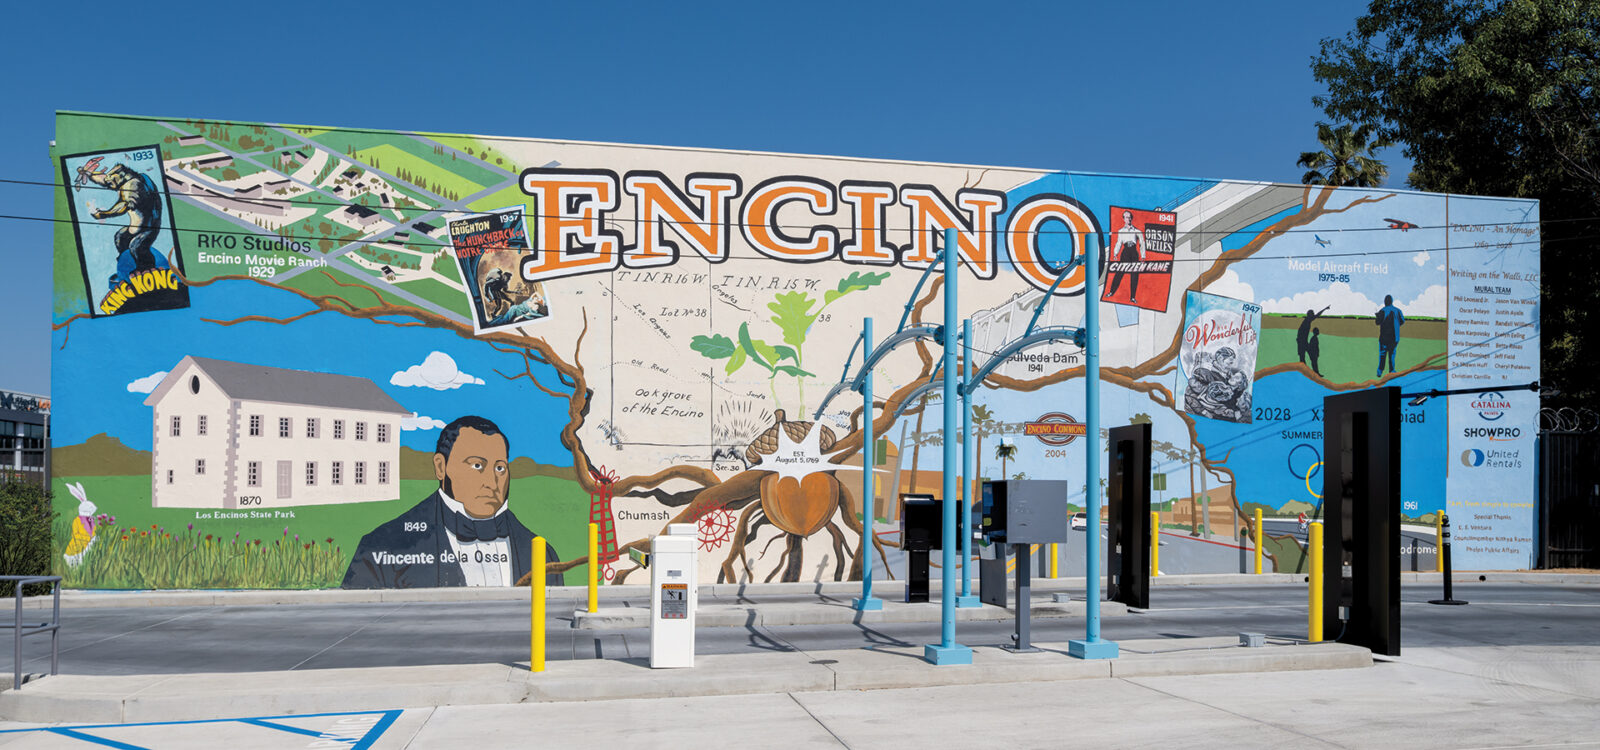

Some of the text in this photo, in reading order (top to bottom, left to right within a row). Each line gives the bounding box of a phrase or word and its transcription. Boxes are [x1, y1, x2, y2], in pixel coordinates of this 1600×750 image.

[133, 150, 154, 161] 1933
[500, 212, 519, 223] 1937
[1159, 214, 1174, 222] 1941
[451, 221, 490, 236] LAUGHTON
[519, 168, 1104, 296] ENCINO
[466, 228, 515, 247] HUNCHBACK
[1145, 228, 1174, 242] ORSON
[197, 234, 311, 253] RKO Studios
[1145, 239, 1173, 253] WELLES
[198, 252, 328, 267] Encino Movie Ranch
[248, 266, 275, 278] 1929
[1109, 262, 1170, 273] CITIZEN KANE
[1288, 260, 1388, 274] Model Aircraft Field
[1318, 273, 1350, 283] 1975-85
[1450, 268, 1477, 280] Writing
[1489, 271, 1500, 279] the
[100, 269, 178, 315] KING KONG
[1474, 286, 1511, 295] MURAL TEAM
[695, 308, 707, 317] 38
[1242, 304, 1260, 313] 1947
[818, 314, 832, 323] 38
[1007, 352, 1078, 364] pulveda Dam
[1028, 364, 1043, 372] 1941
[656, 390, 692, 405] grove
[622, 402, 639, 413] of
[640, 402, 657, 415] the
[1471, 401, 1511, 409] CATALINA
[1255, 408, 1291, 421] 2028
[1281, 430, 1323, 440] SUMMER
[1464, 428, 1520, 437] SHOWPRO
[1045, 449, 1066, 457] 2004
[1487, 450, 1519, 458] United
[775, 456, 798, 464] August
[1487, 459, 1521, 468] Rentals
[240, 496, 262, 505] 1870
[1403, 501, 1418, 510] 1961
[214, 511, 248, 519] Encinos
[250, 511, 272, 519] State
[275, 511, 295, 519] Park
[618, 510, 670, 521] Chumash
[404, 522, 428, 532] 1849
[1400, 544, 1437, 555] odrome
[372, 549, 508, 565] Vincente de la Ossa
